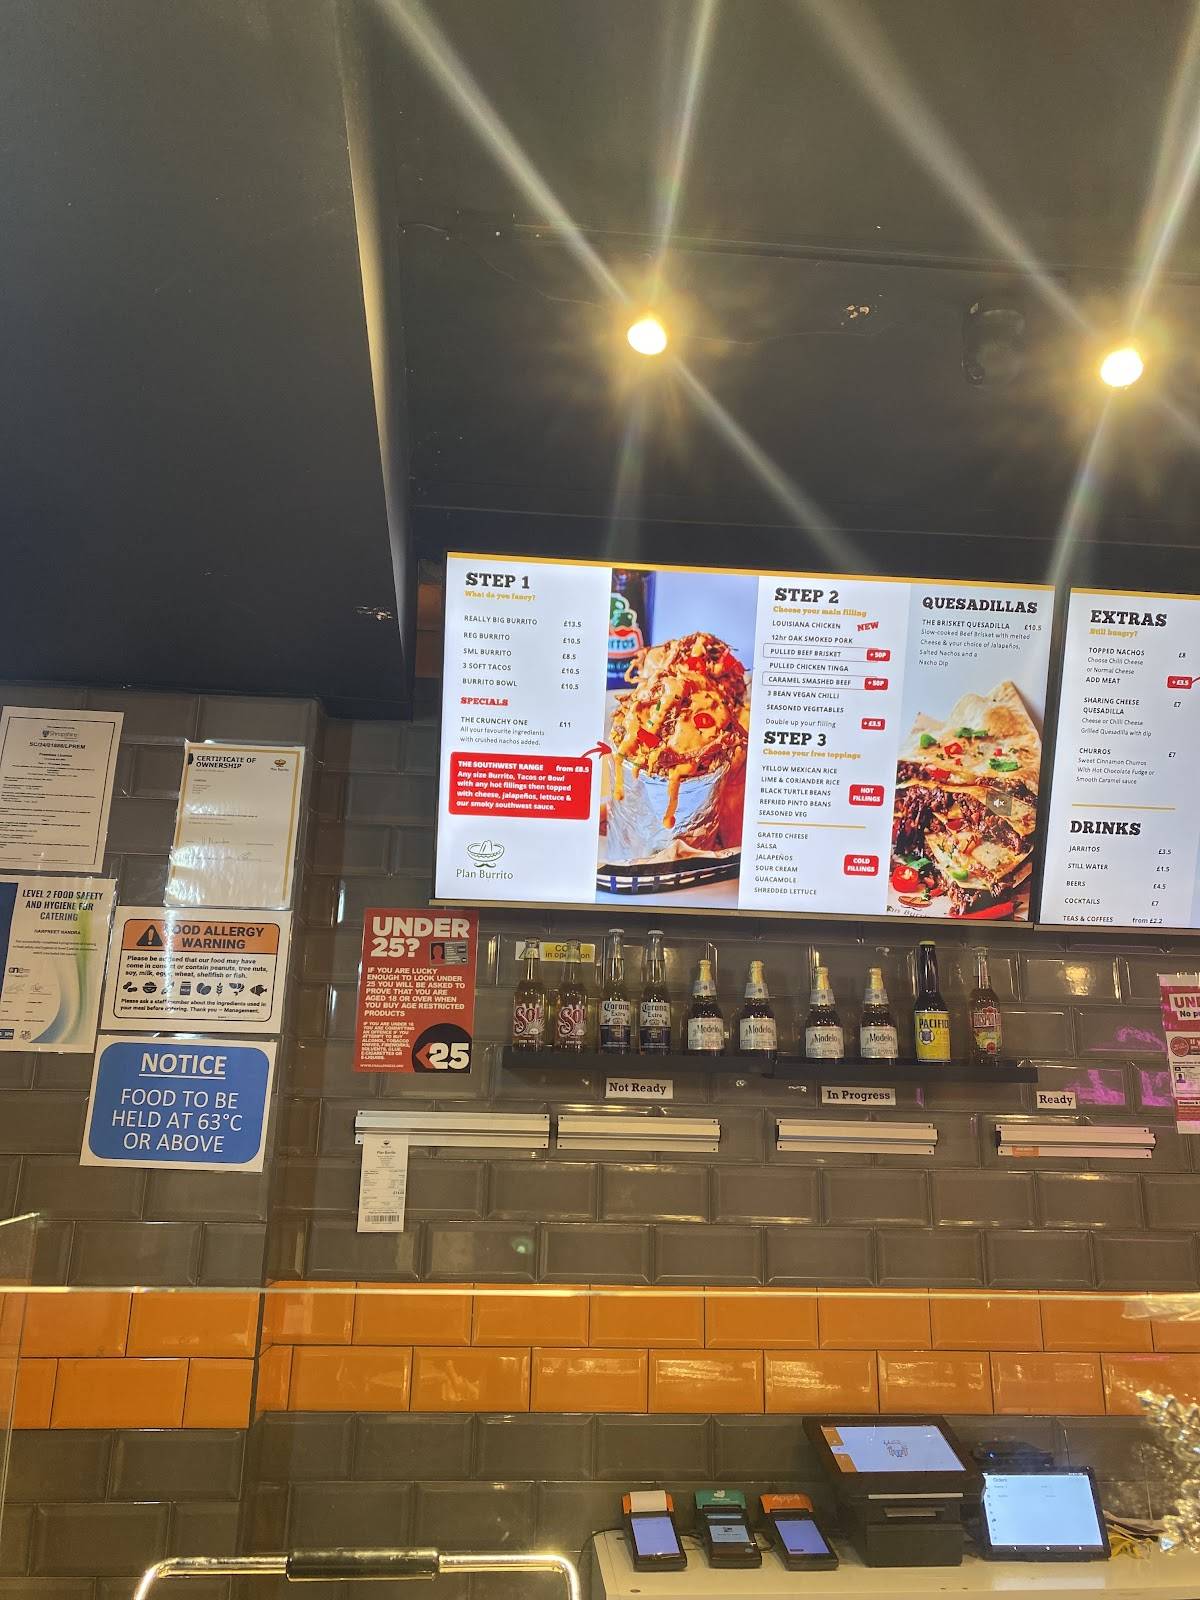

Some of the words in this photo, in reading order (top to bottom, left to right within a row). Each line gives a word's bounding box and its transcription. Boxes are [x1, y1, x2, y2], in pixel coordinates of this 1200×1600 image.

[466, 572, 516, 588] STEP
[522, 576, 529, 589] 1
[774, 587, 823, 603] STEP
[828, 590, 838, 603] 2
[922, 596, 1037, 613] QUESADILLAS
[773, 606, 801, 614] Choose
[842, 608, 867, 618] filling
[464, 614, 491, 622] REALLY
[506, 617, 537, 625] BURRITO
[1090, 610, 1167, 627] EXTRAS
[857, 621, 879, 631] NEW
[966, 621, 1009, 629] QUESADILLA
[479, 632, 510, 640] BURRITO
[1107, 628, 1137, 638] hungry?
[1116, 648, 1144, 656] NACHOS
[488, 663, 511, 671] TACOS
[460, 697, 508, 706] SPECIALS
[476, 717, 511, 725] CRUNCHY
[764, 731, 812, 745] STEP
[817, 733, 826, 746] 3
[472, 761, 517, 769] SOUTHWEST
[518, 763, 543, 771] RANGE
[503, 781, 527, 790] fillings
[528, 782, 545, 790] then
[546, 784, 571, 792] topped
[1070, 820, 1141, 835] DRINKS
[1068, 845, 1100, 853] JARRITOS
[456, 868, 476, 878] Plan
[479, 869, 513, 881] Burrito
[22, 889, 43, 898] LEVEL
[46, 890, 51, 898] 2
[53, 890, 74, 899] FOOD
[76, 891, 103, 900] SAFETY
[25, 900, 42, 908] AND
[44, 901, 76, 910] HYGIENE
[78, 902, 93, 911] FOR
[40, 912, 78, 921] CATERING
[172, 924, 200, 935] OOD
[372, 917, 470, 938] UNDER
[182, 938, 245, 949] WARNING
[370, 937, 420, 957] 25?
[604, 1003, 629, 1012] Corona
[642, 1003, 667, 1013] Corona
[1180, 1010, 1191, 1018] No
[429, 1043, 470, 1070] 25
[141, 1053, 227, 1075] NOTICE
[608, 1080, 630, 1092] Not
[631, 1081, 667, 1095] Ready
[121, 1088, 176, 1106] FOOD
[182, 1090, 208, 1108] TO
[215, 1092, 239, 1109] BE
[826, 1090, 839, 1099] In
[841, 1089, 892, 1101] Progress
[1038, 1094, 1073, 1106] Ready
[112, 1110, 161, 1127] HELD
[166, 1112, 193, 1129] AT
[198, 1113, 242, 1131] 63°C
[124, 1132, 150, 1149] OR
[156, 1134, 224, 1152] ABOVE
